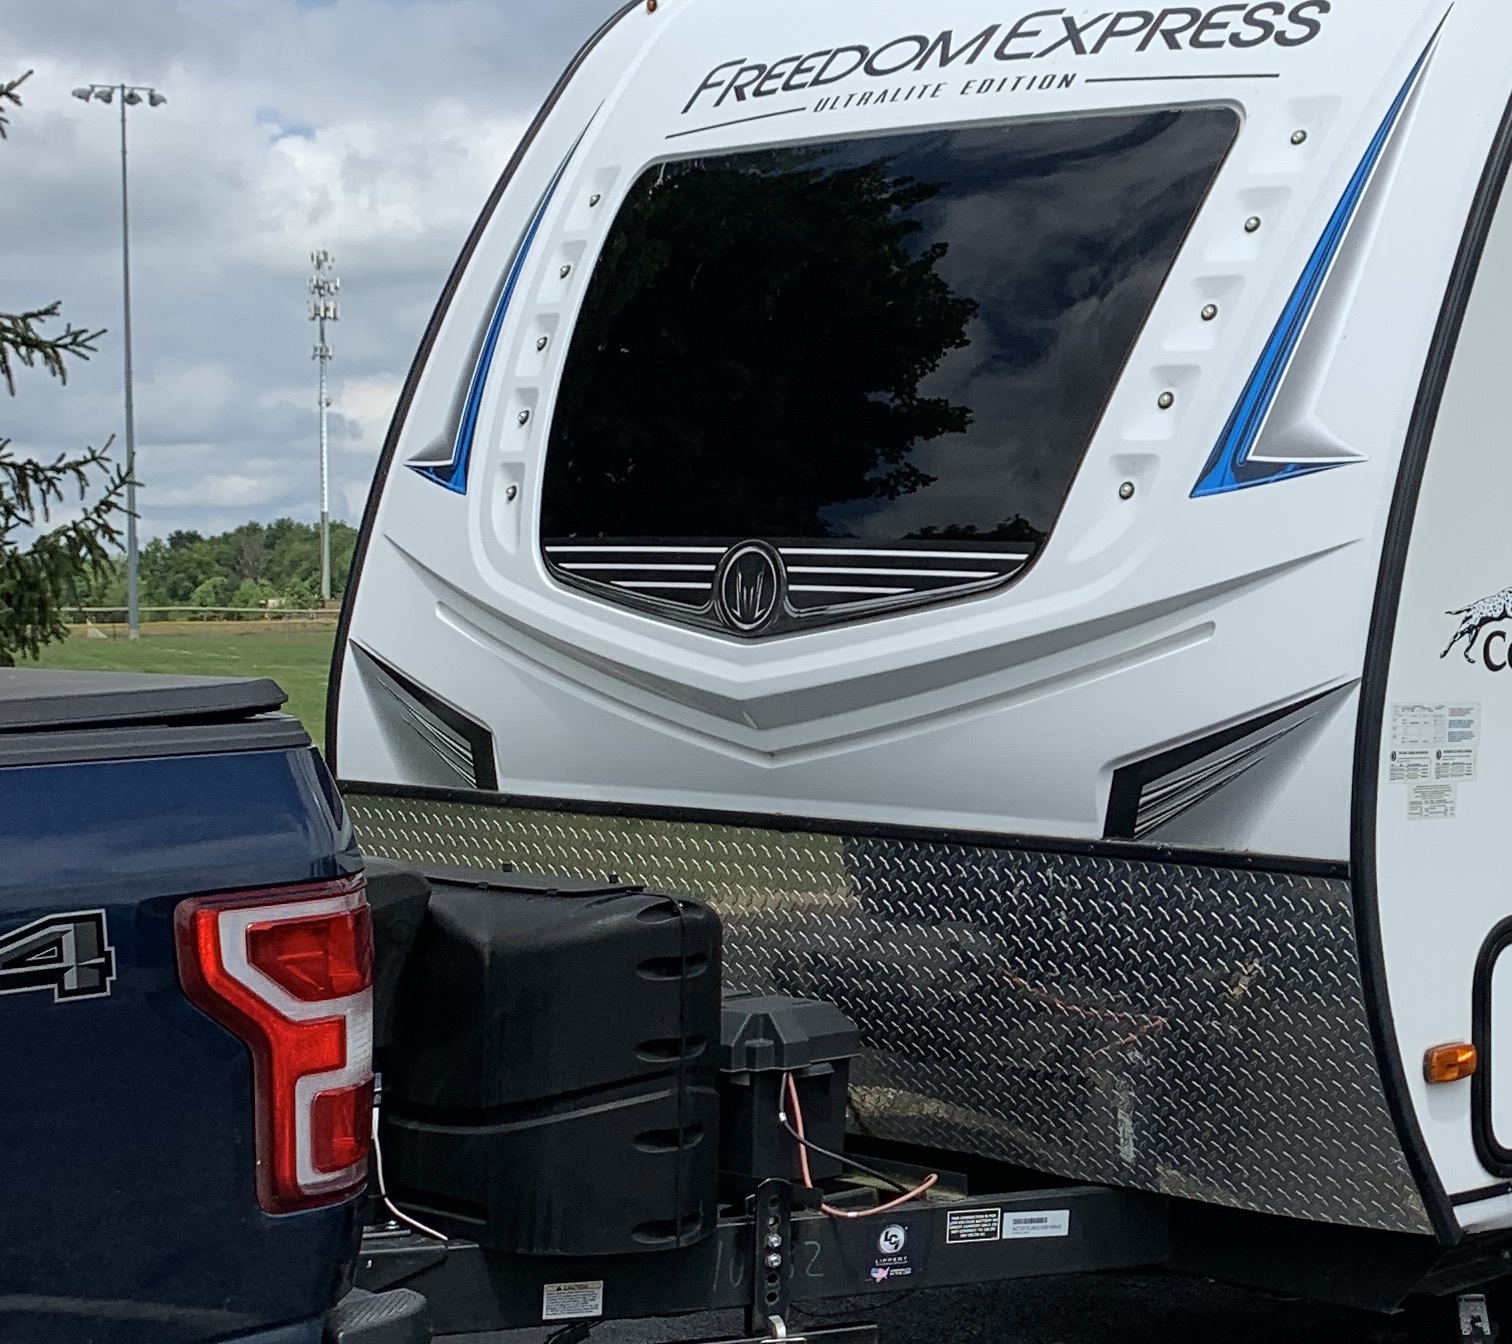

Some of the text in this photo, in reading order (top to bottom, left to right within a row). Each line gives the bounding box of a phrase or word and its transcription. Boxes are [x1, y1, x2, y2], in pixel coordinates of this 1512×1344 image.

[681, 0, 1331, 114] FREEDOM EXPRESS
[813, 72, 1077, 113] ULTRALITE EDITION
